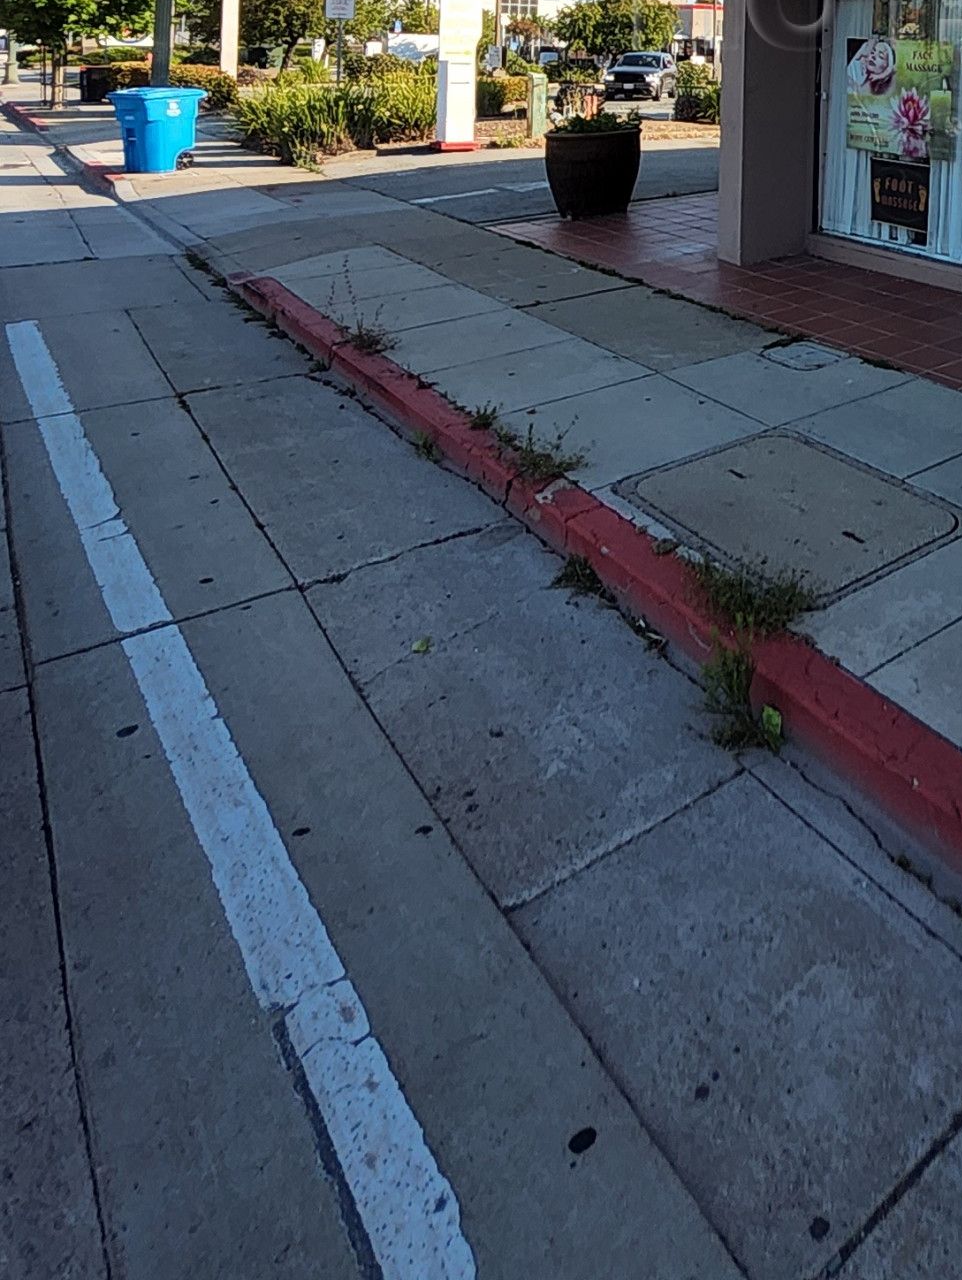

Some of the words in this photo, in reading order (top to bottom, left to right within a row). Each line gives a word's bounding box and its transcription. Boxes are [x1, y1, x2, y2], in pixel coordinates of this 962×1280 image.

[912, 51, 934, 61] FACE
[905, 62, 944, 74] MASSAGE
[885, 177, 914, 194] FOOT
[881, 195, 918, 211] MASSAGE
